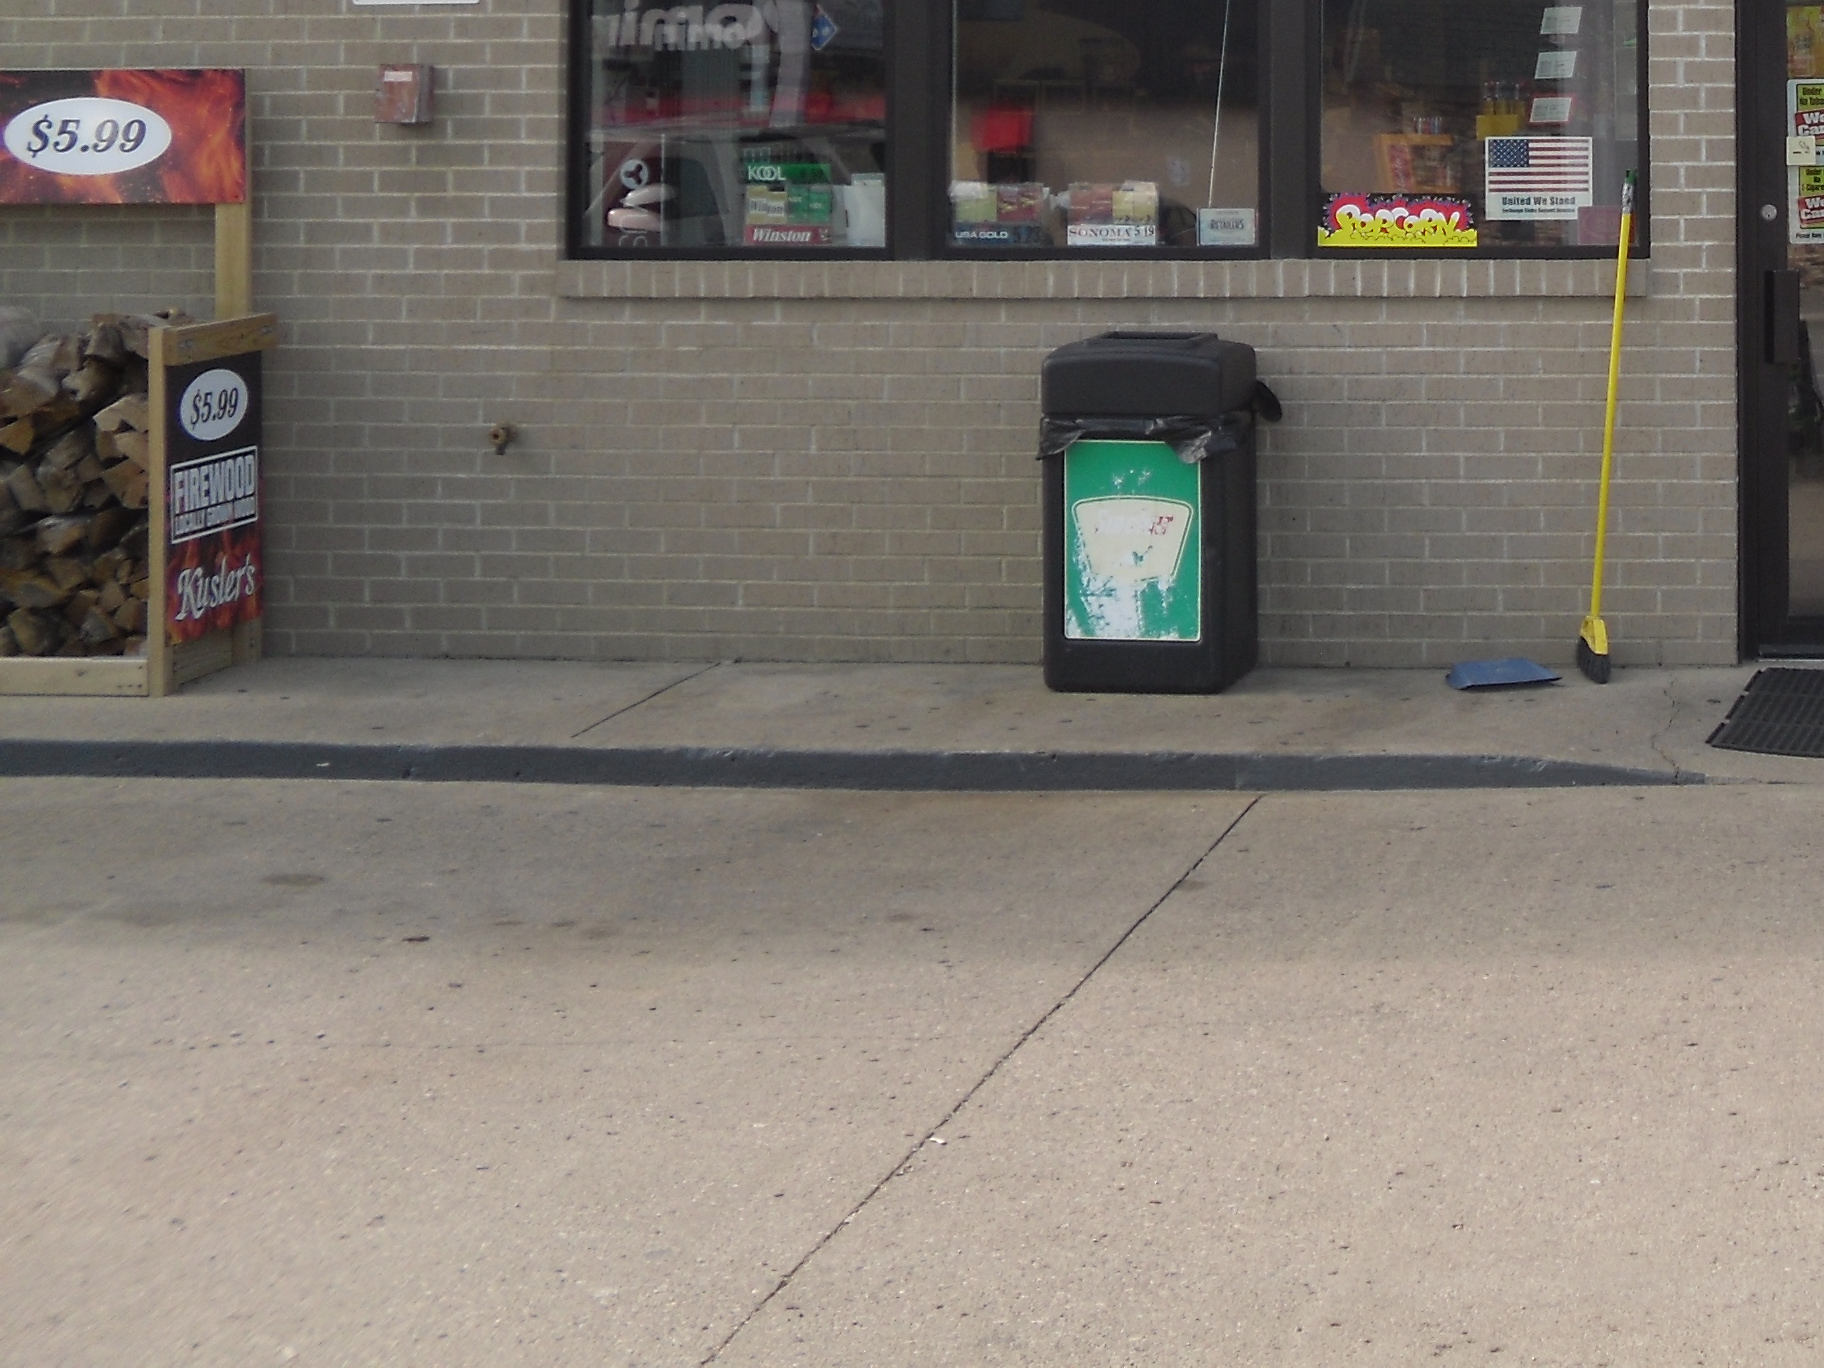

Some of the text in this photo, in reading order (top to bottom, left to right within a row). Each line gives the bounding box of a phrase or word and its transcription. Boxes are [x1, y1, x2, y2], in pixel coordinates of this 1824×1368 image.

[27, 114, 147, 158] $5.99
[748, 165, 786, 181] KOOL
[1501, 196, 1576, 205] United We Stand
[752, 228, 812, 242] Winston
[1069, 226, 1132, 238] SONOMA
[1336, 203, 1460, 236] POPCORN
[190, 387, 239, 430] $5.99
[174, 454, 255, 515] FIREWOOD
[174, 552, 256, 621] Kusler's
